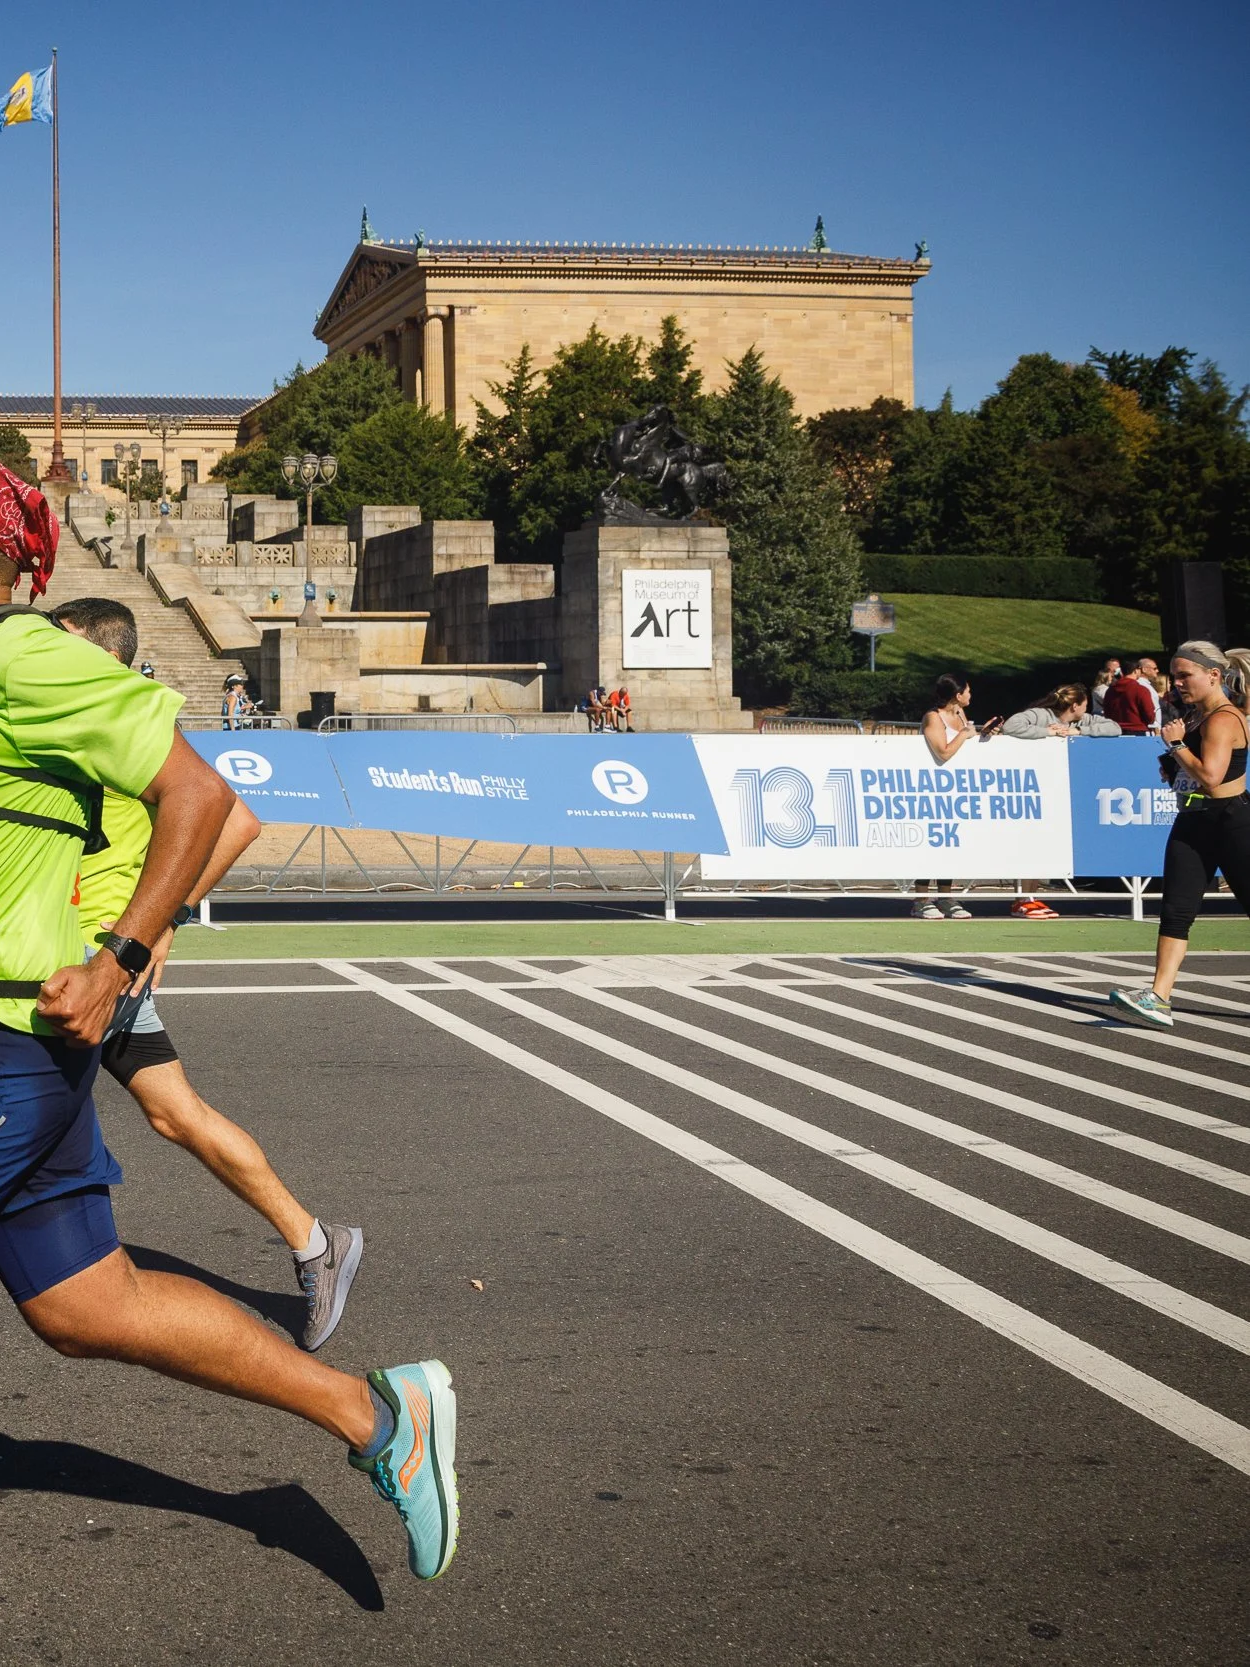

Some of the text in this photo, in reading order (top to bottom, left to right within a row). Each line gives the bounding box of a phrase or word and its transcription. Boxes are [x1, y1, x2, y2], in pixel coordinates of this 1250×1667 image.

[635, 579, 700, 591] Philadelphia
[635, 590, 699, 600] Museum of
[630, 601, 700, 638] Art
[480, 774, 526, 789] PHILLY
[860, 769, 1041, 793] PHILADELPHIA
[273, 790, 320, 799] RUNNER
[485, 786, 530, 801] STYLE
[566, 809, 697, 820] PHILADELPHIA RUNNER
[863, 795, 1043, 820] DISTANCE RUN
[866, 822, 960, 848] AND 5K
